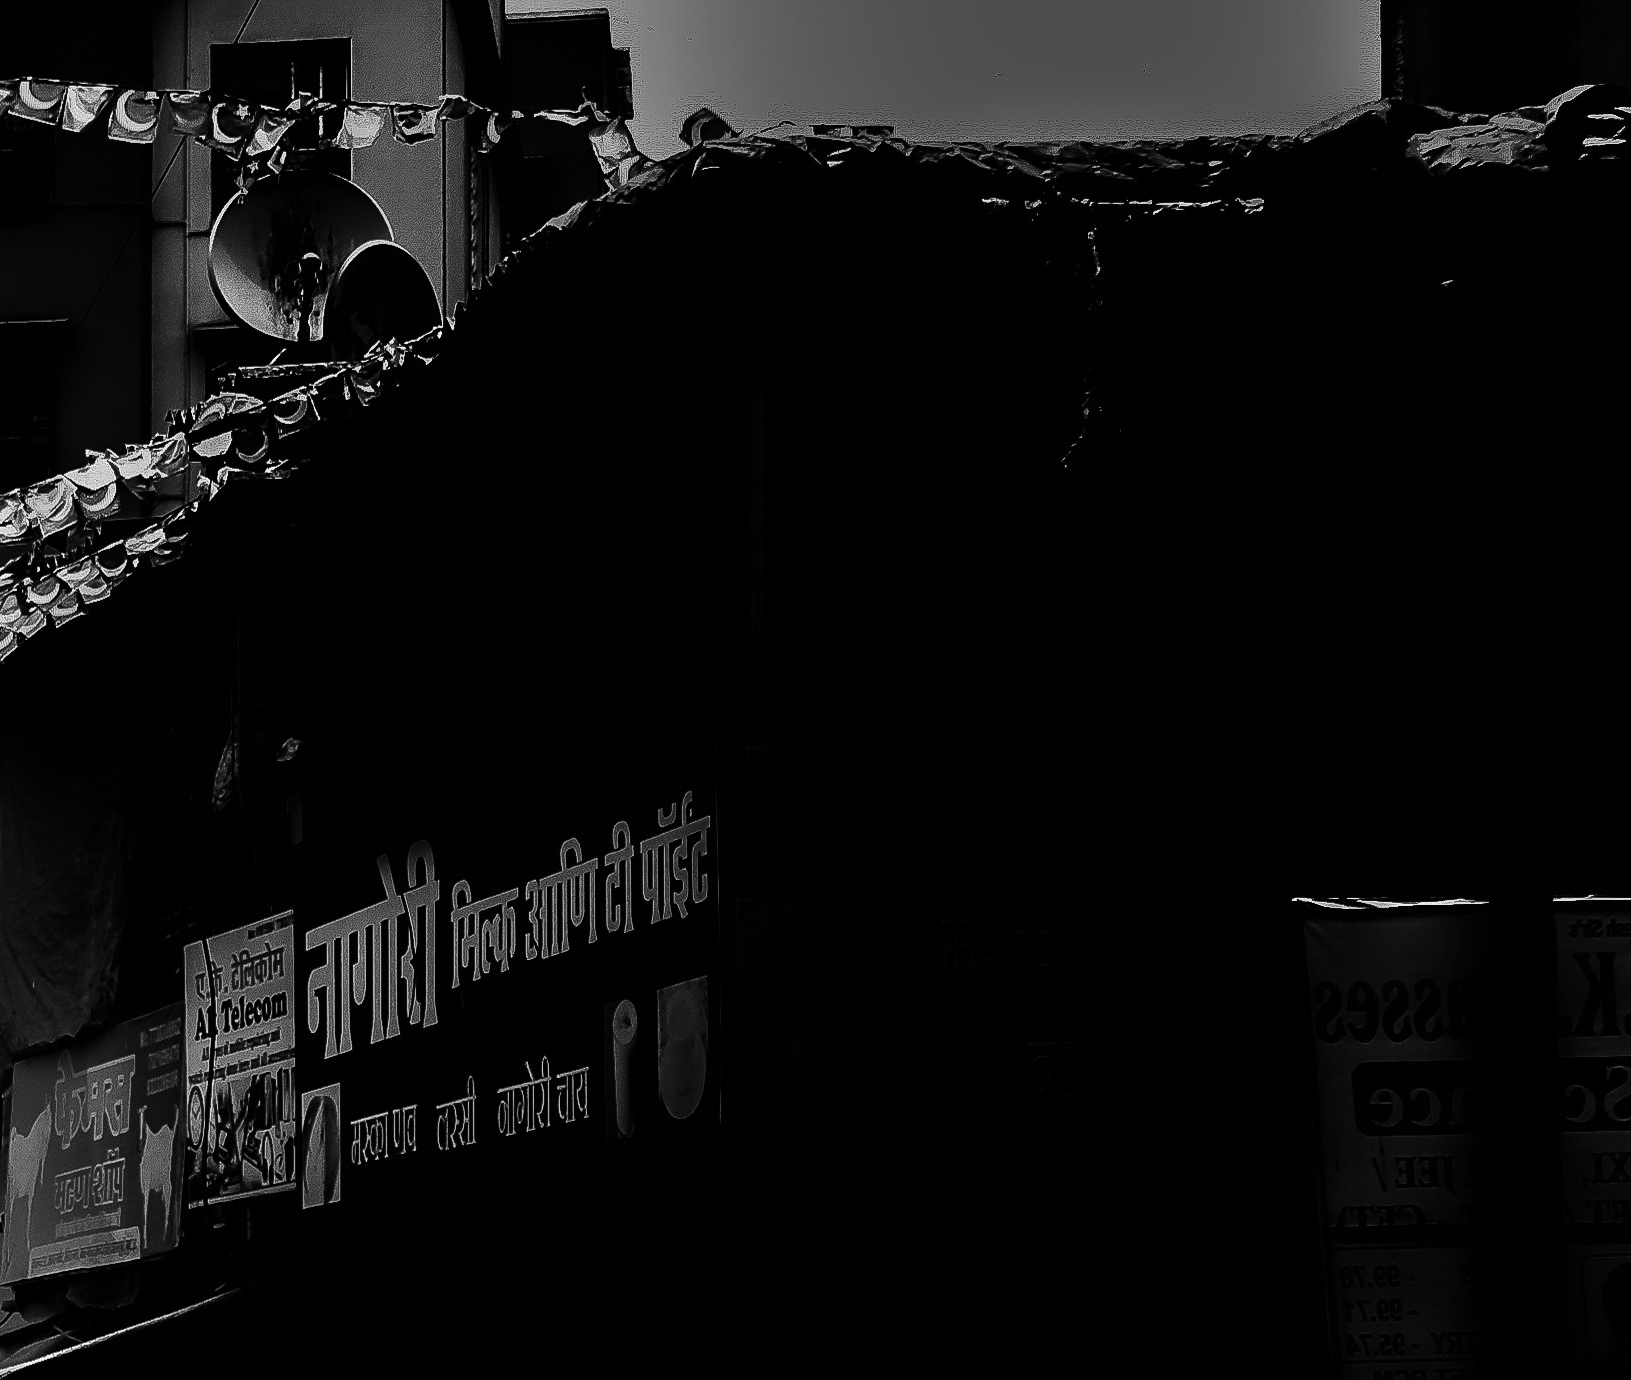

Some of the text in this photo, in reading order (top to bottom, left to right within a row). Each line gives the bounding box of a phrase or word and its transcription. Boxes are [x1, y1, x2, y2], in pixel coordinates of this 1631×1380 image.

[304, 838, 440, 1060] नागोरी
[449, 878, 520, 990] मिल्क
[523, 836, 599, 961] आणि
[603, 820, 635, 935] टी
[221, 991, 288, 1033] Telecom
[496, 1054, 552, 1137] नागोरी
[555, 1065, 590, 1125] चाय
